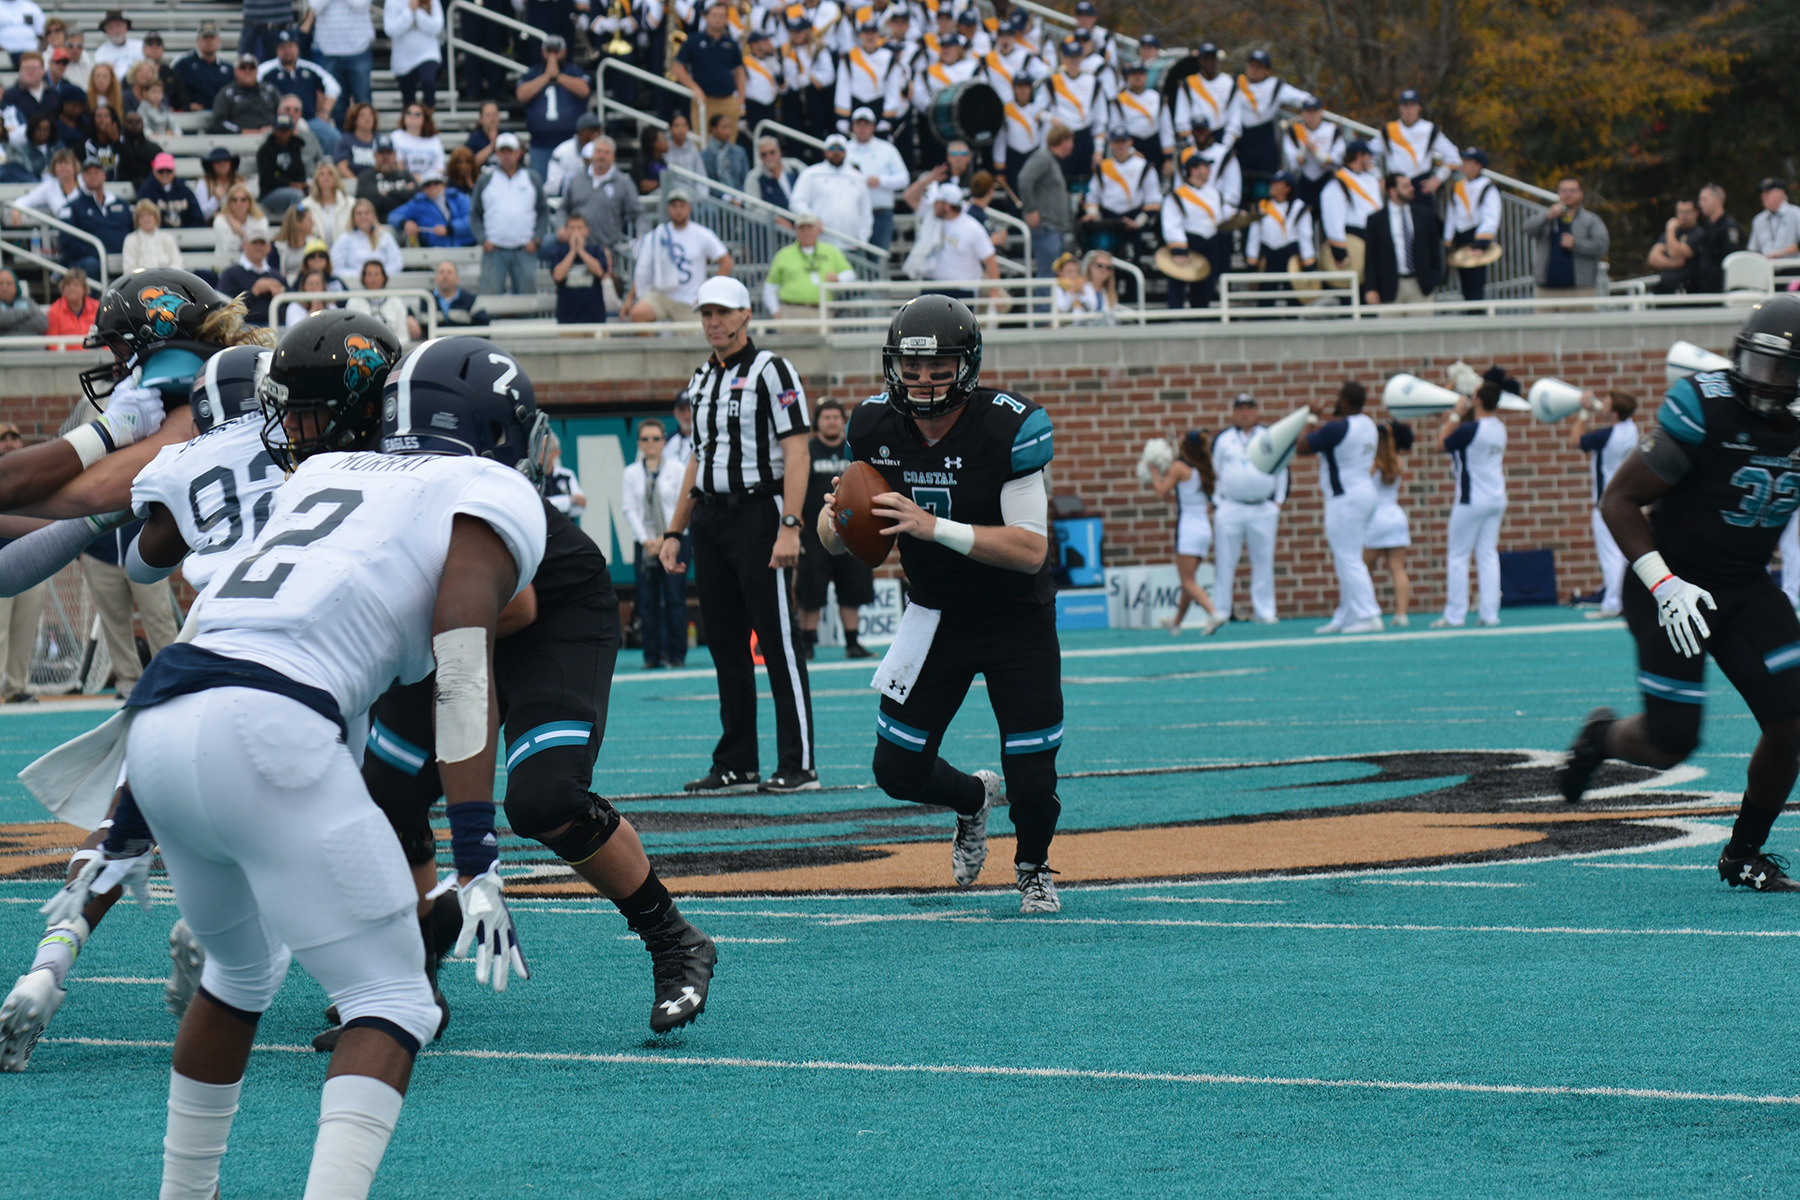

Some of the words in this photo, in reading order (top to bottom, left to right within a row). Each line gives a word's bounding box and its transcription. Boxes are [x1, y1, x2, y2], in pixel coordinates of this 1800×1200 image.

[544, 85, 559, 121] 1
[488, 353, 520, 400] 2
[992, 393, 1026, 415] 7
[384, 436, 420, 452] EAGLES
[329, 451, 441, 472] MURRAY
[903, 470, 957, 485] COASTAL
[1719, 465, 1800, 528] 32
[214, 487, 364, 599] 2
[858, 613, 896, 636] OISE
